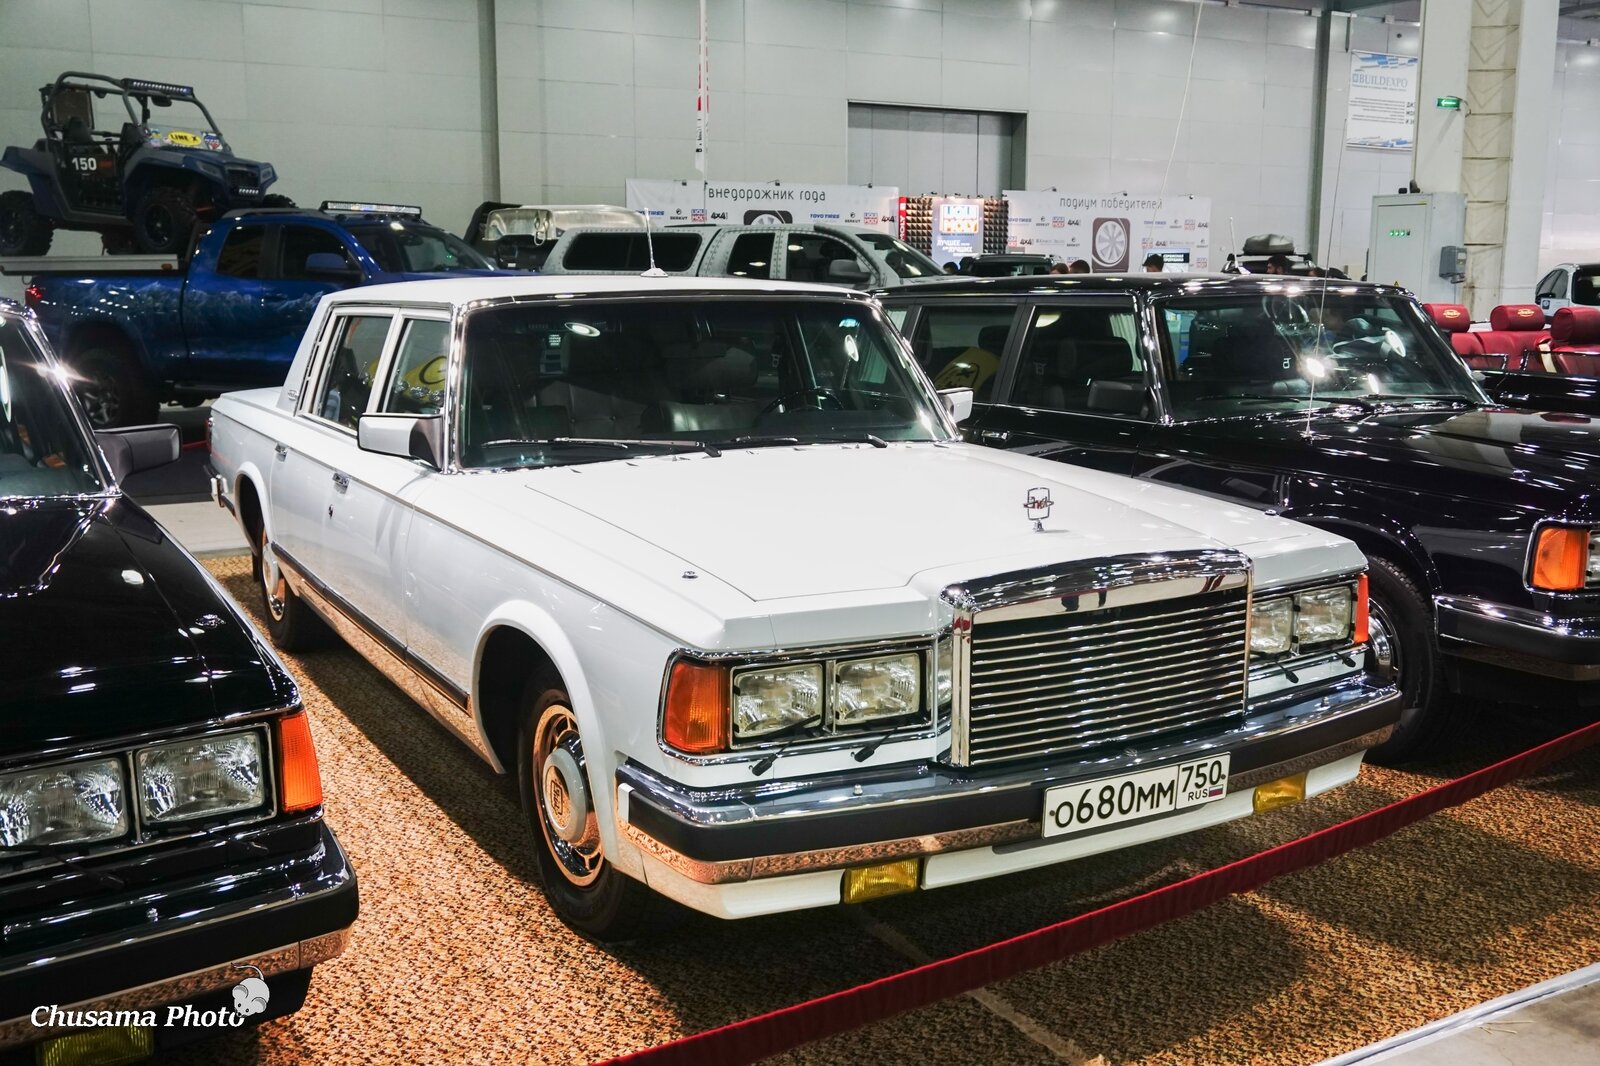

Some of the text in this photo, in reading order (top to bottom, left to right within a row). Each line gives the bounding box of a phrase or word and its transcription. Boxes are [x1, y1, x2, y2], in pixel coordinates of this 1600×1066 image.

[1360, 74, 1408, 89] BUILDEXPO
[170, 134, 188, 142] LINE
[72, 157, 97, 171] 150
[708, 188, 826, 203] внедорожник года
[1060, 197, 1097, 209] подиум
[1181, 760, 1222, 793] 750
[1187, 788, 1208, 801] RUS
